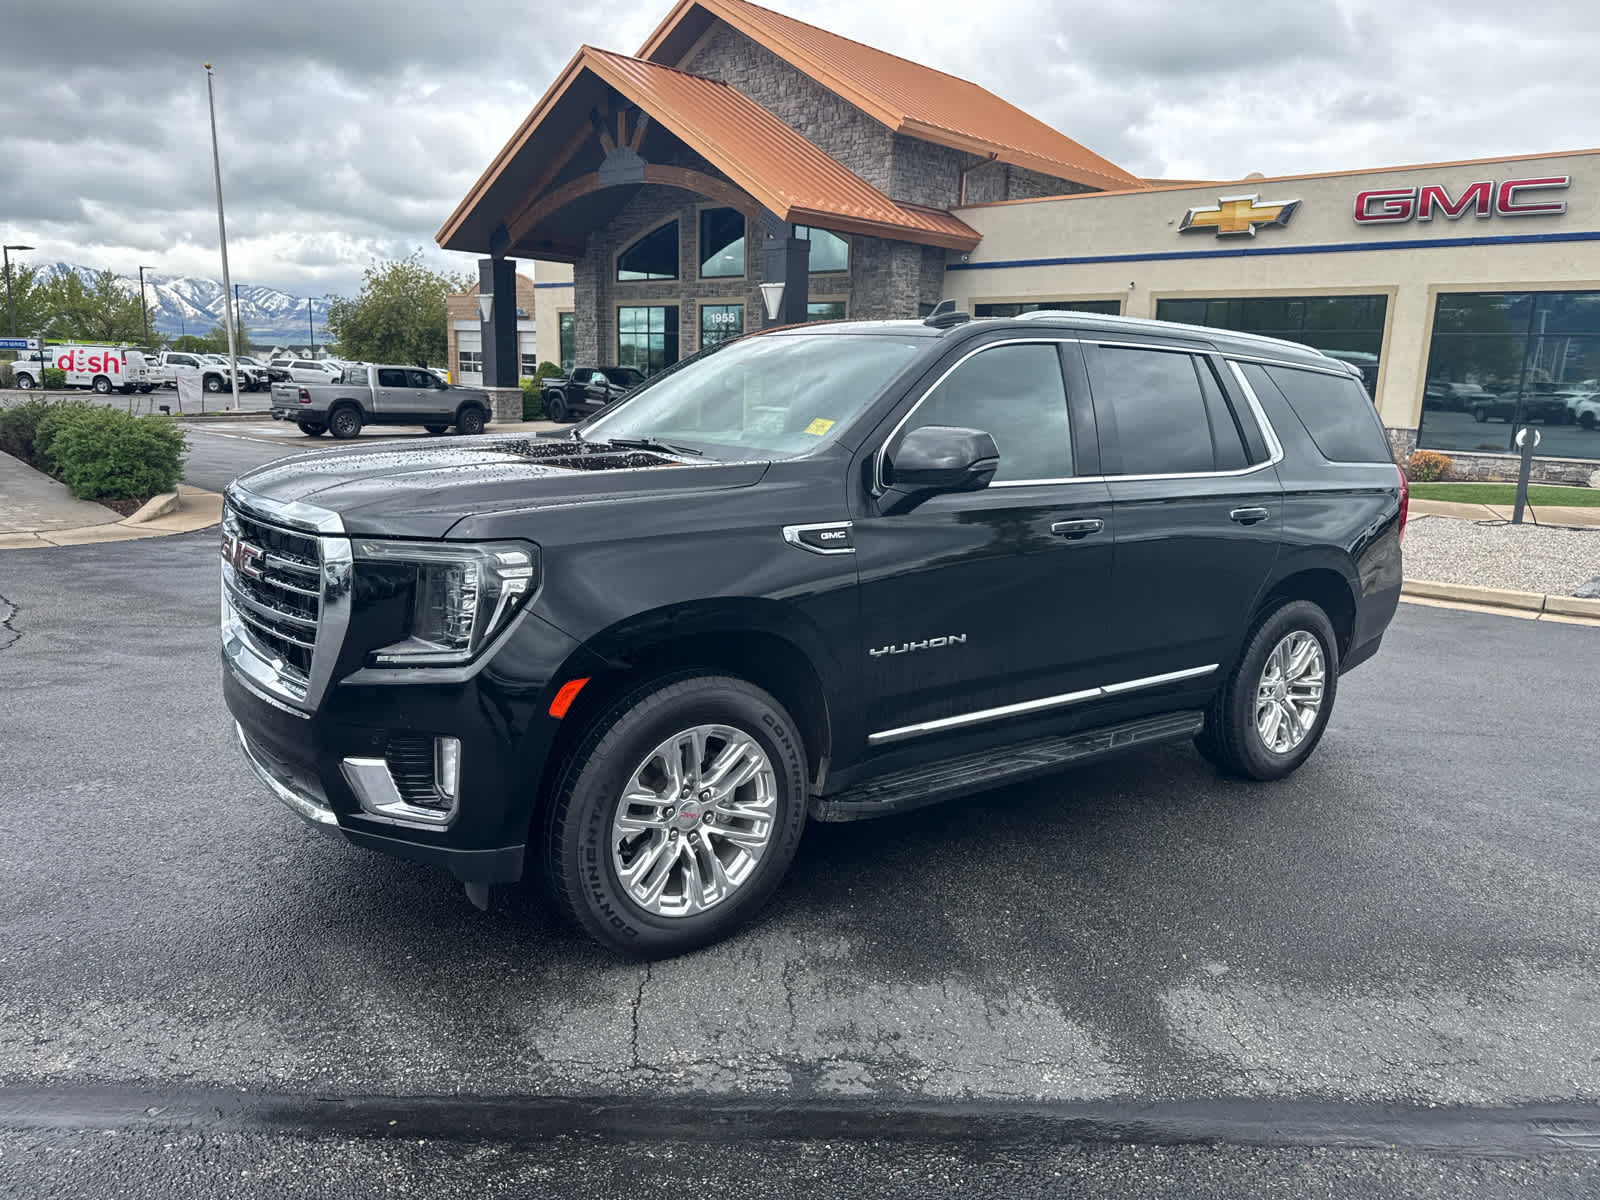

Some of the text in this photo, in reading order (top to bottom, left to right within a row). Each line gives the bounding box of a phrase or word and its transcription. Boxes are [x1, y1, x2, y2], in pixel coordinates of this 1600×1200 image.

[1354, 175, 1570, 225] GMC
[711, 312, 736, 324] 1955
[57, 349, 119, 374] dish
[821, 531, 846, 540] GMC
[869, 633, 967, 658] YUKON
[586, 784, 639, 937] CONTINENTAL
